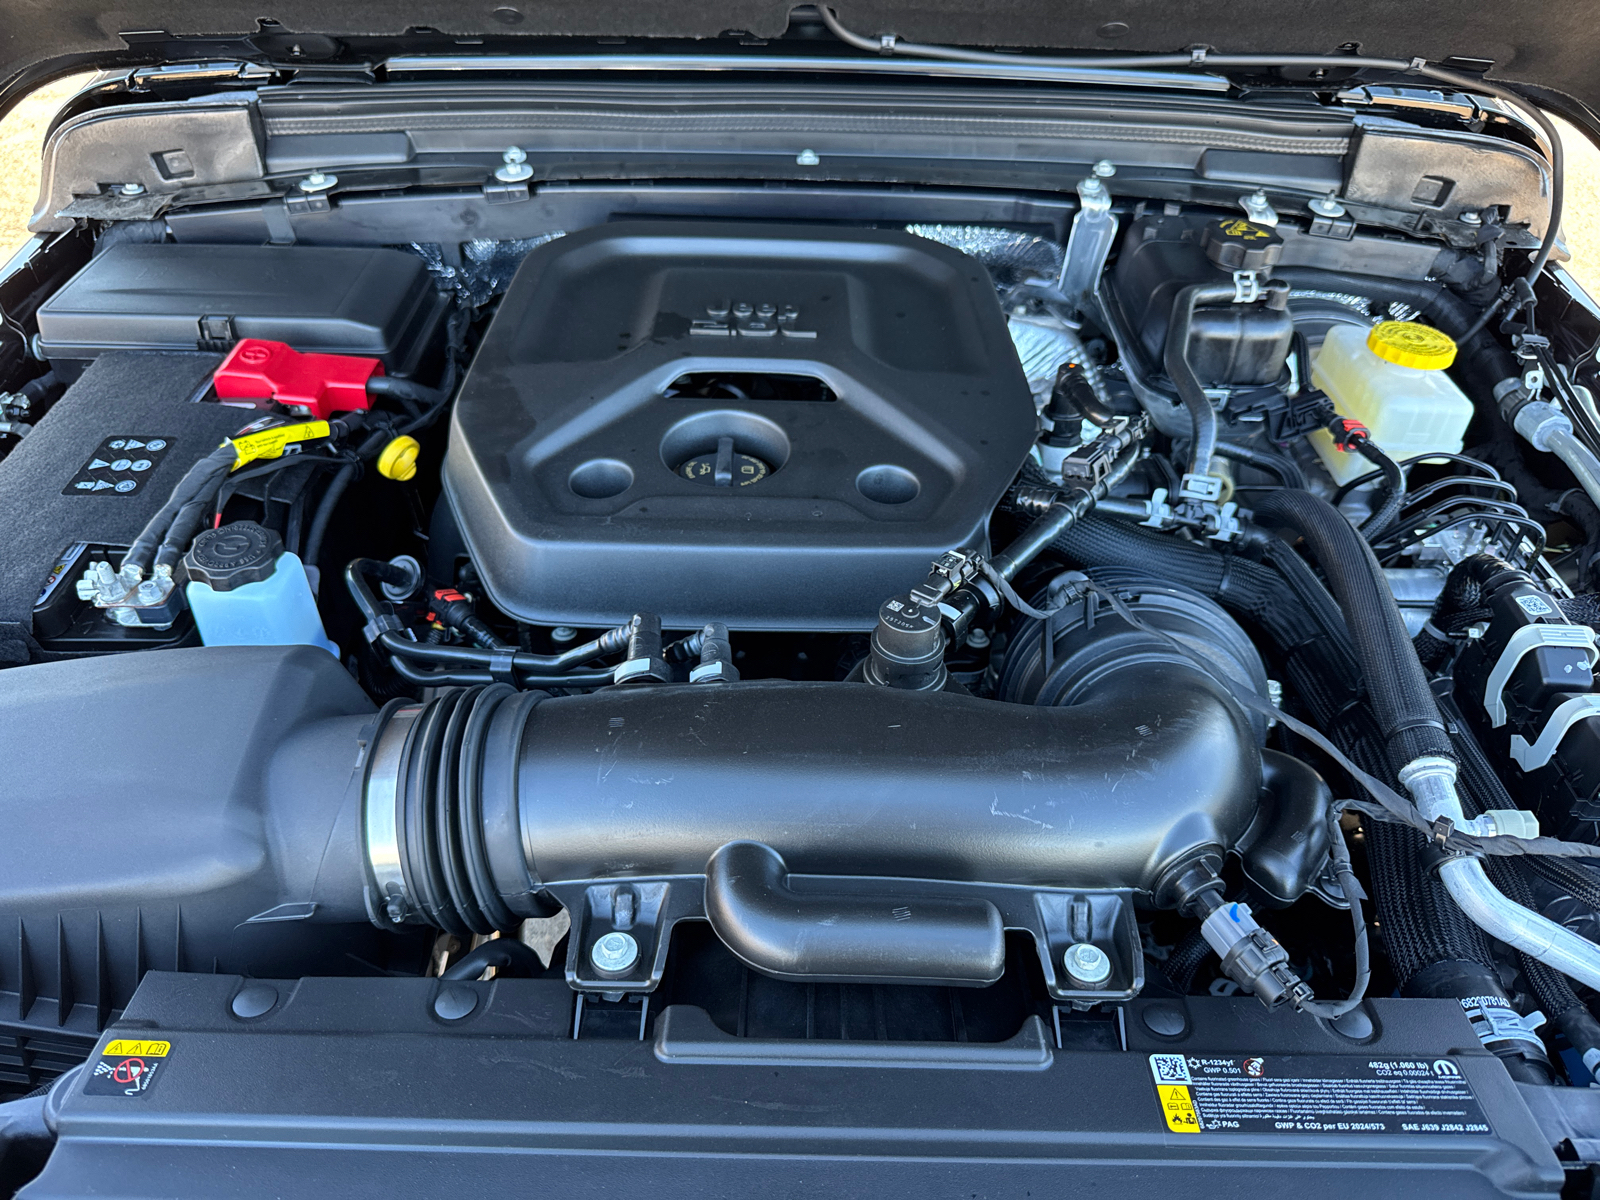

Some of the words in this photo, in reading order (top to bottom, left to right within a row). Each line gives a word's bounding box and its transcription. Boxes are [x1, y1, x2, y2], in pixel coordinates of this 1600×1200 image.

[1274, 1121, 1294, 1129] GWP
[1304, 1122, 1322, 1130] CO2
[1323, 1123, 1336, 1131] per
[1337, 1122, 1349, 1130] EU
[1401, 1123, 1420, 1131] SAE
